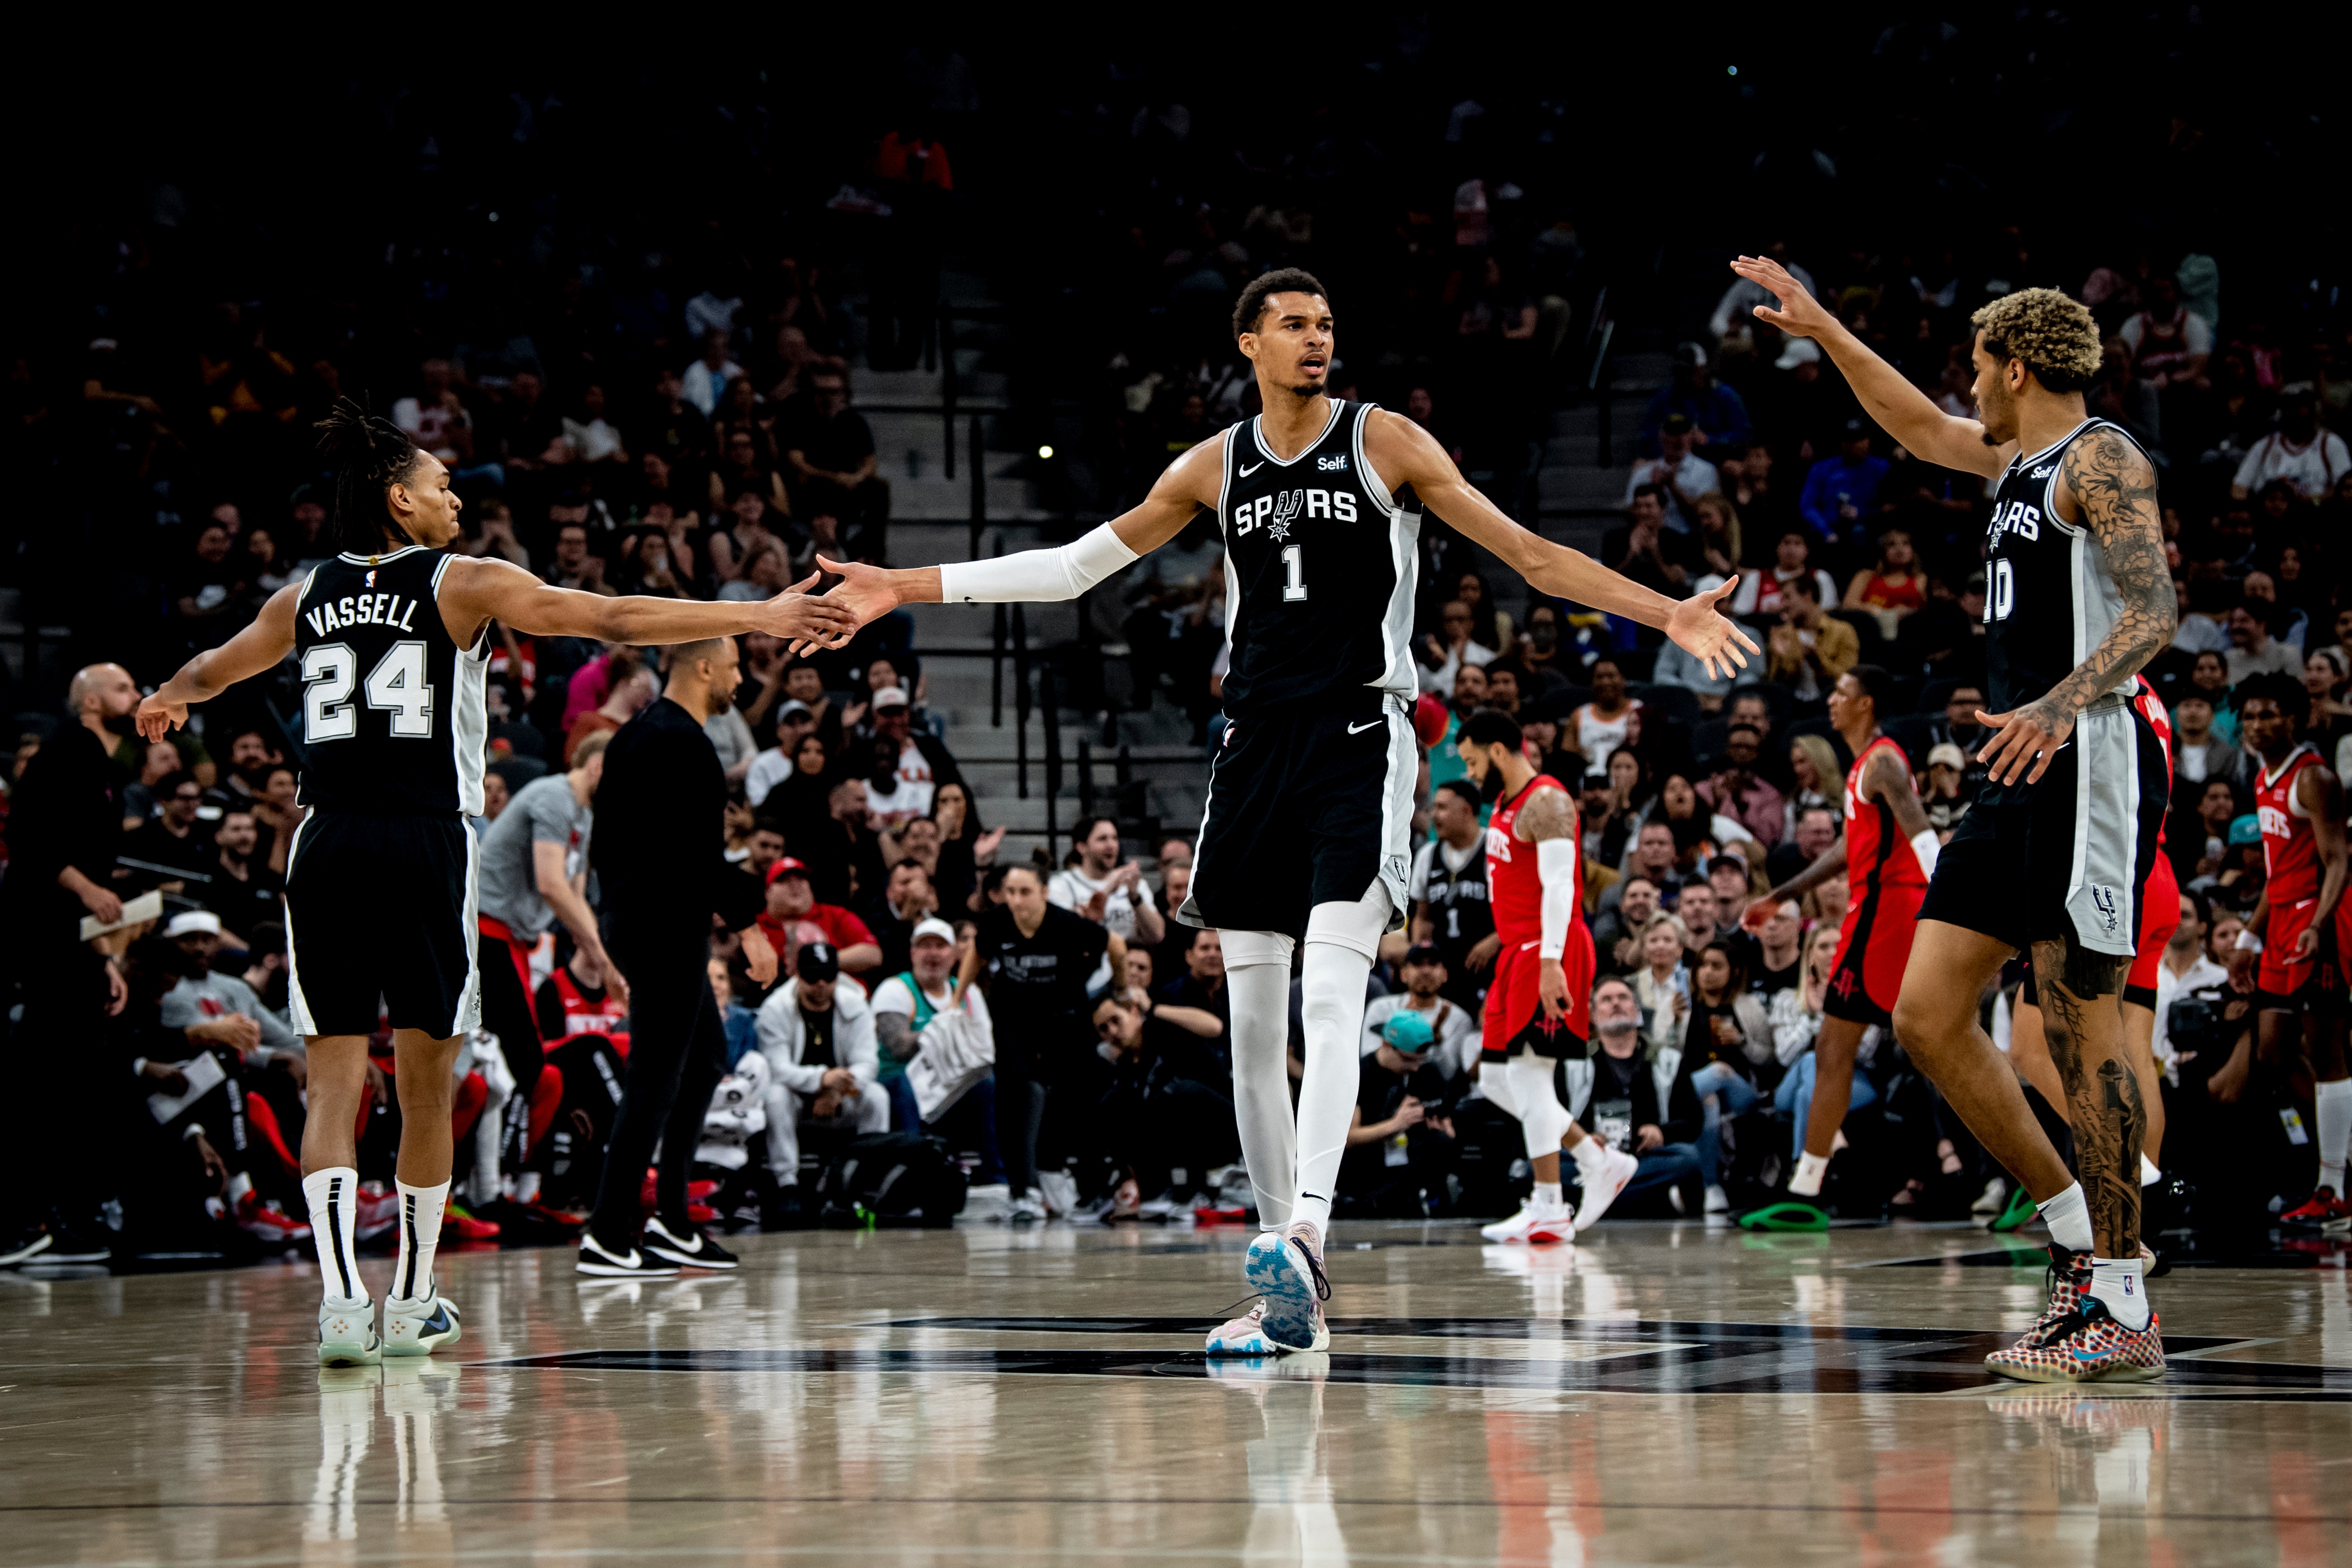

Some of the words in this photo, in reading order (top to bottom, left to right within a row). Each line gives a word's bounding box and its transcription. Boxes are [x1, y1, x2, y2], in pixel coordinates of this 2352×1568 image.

[1317, 455, 1348, 470] Self.
[1235, 488, 1358, 543] SPURS
[1985, 497, 2040, 555] PURS
[1281, 544, 1307, 602] 1
[1982, 557, 2014, 624] 10
[305, 592, 418, 638] VASSELL
[301, 639, 435, 745] 24
